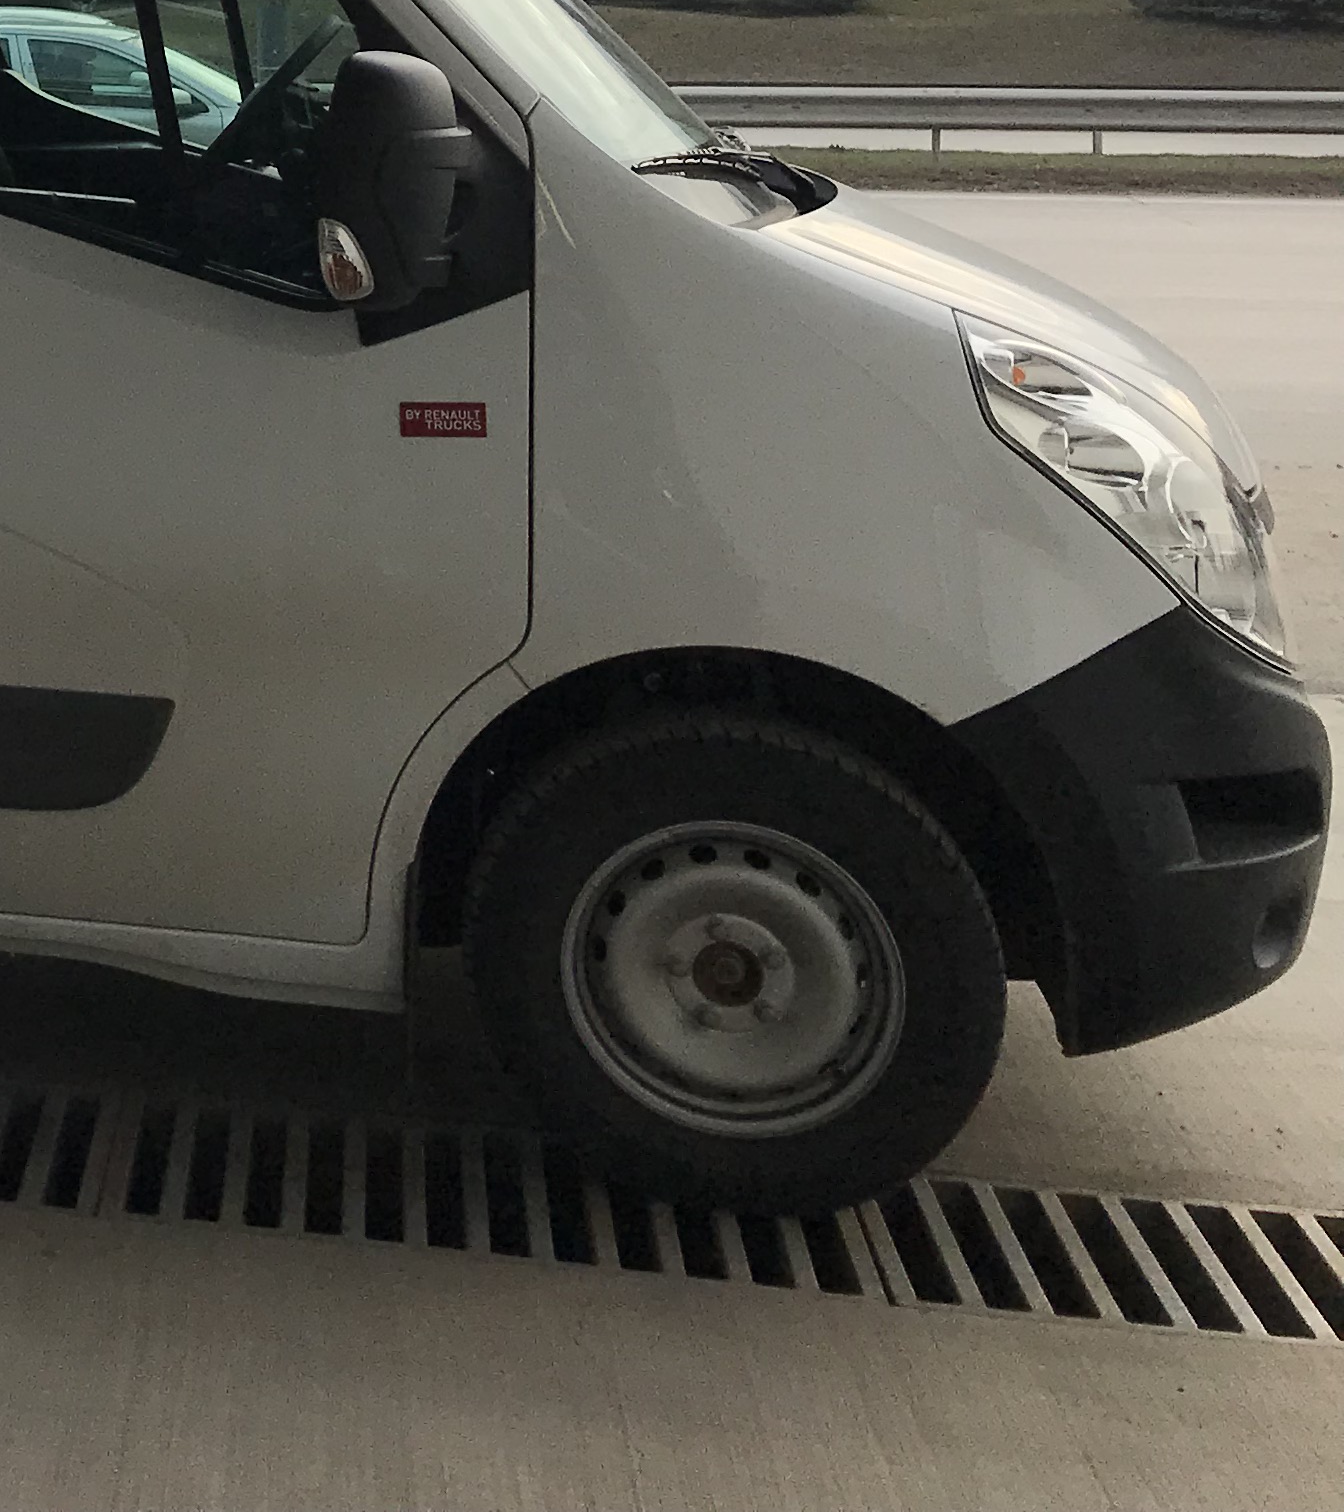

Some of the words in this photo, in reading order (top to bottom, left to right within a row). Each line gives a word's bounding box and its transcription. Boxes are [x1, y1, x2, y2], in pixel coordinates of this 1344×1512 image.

[405, 409, 421, 420] BY
[424, 409, 481, 420] RENAULT
[425, 419, 482, 431] TRUCKS
